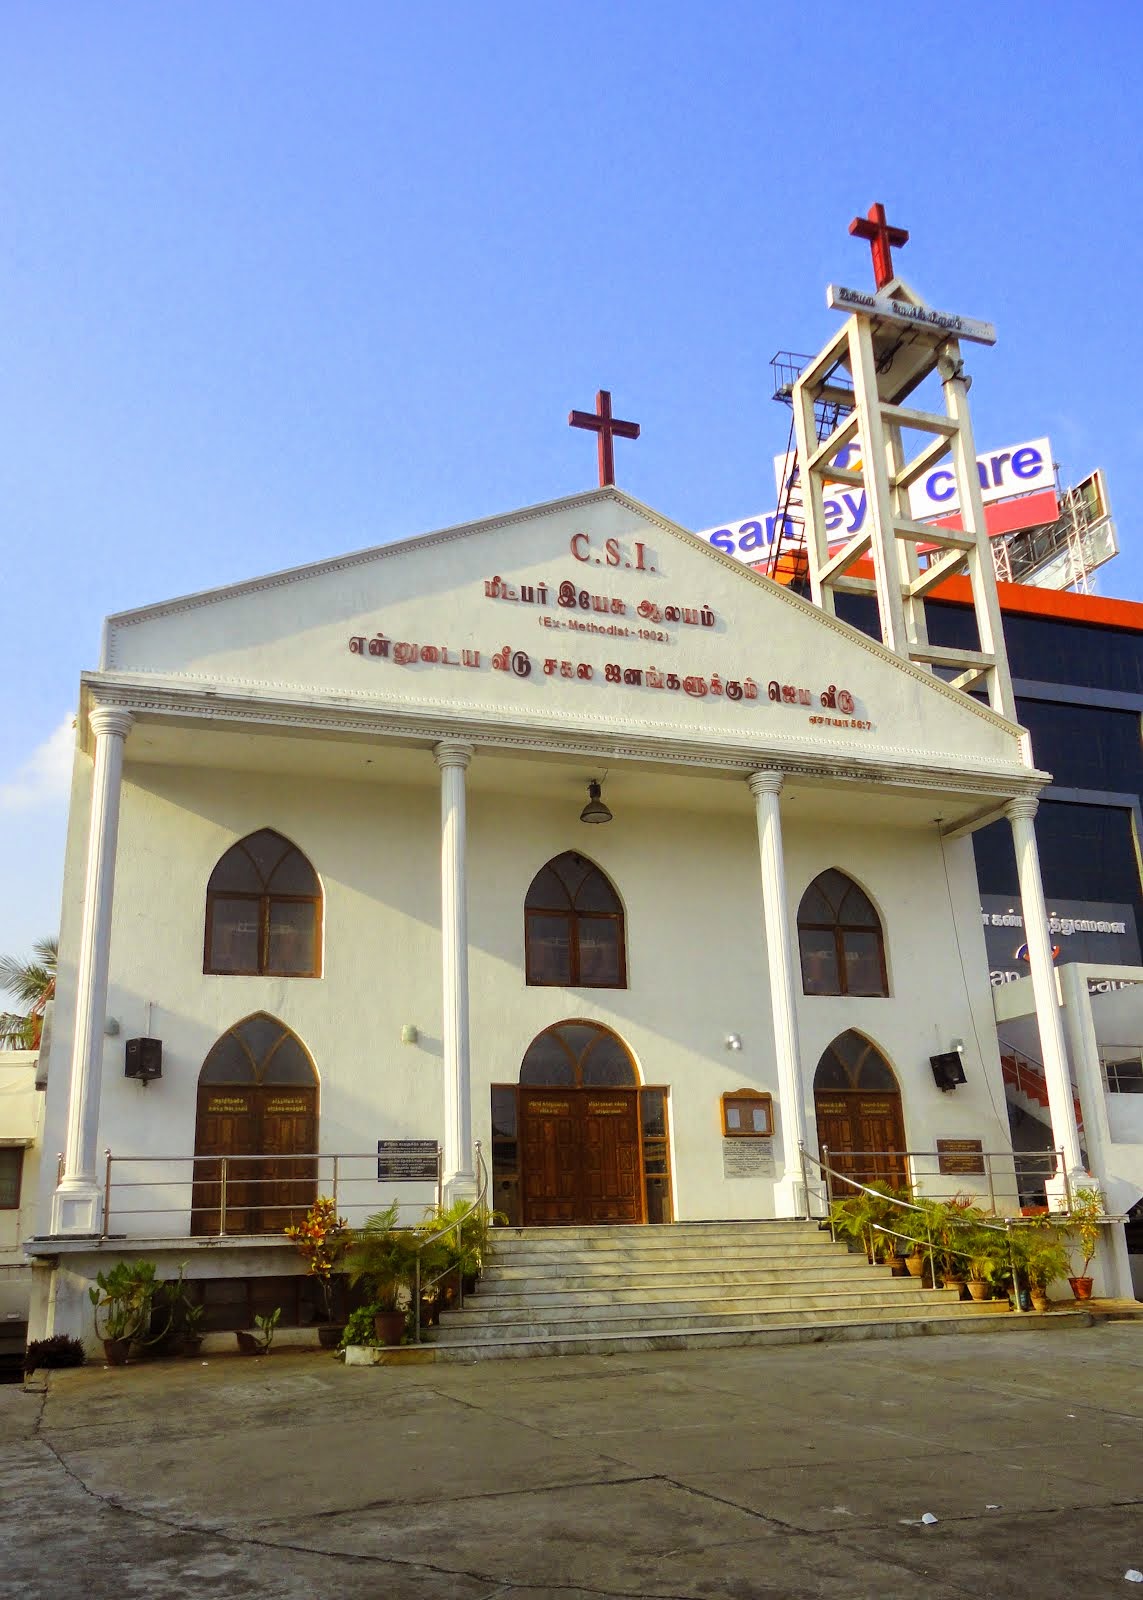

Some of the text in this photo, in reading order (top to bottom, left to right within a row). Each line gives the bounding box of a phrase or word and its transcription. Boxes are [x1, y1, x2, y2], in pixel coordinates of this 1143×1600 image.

[709, 511, 795, 555] san
[823, 490, 868, 533] ey
[570, 533, 656, 572] C.S.I.
[484, 575, 715, 627] மீட்பர் இயேசு ஆலயம்
[348, 632, 855, 715] என்னுடைய வீடு சகல ஜனங்களுக்கும் ஜெப வீடு
[850, 720, 873, 731] 56:7
[1047, 911, 1126, 936] த்துவமனை
